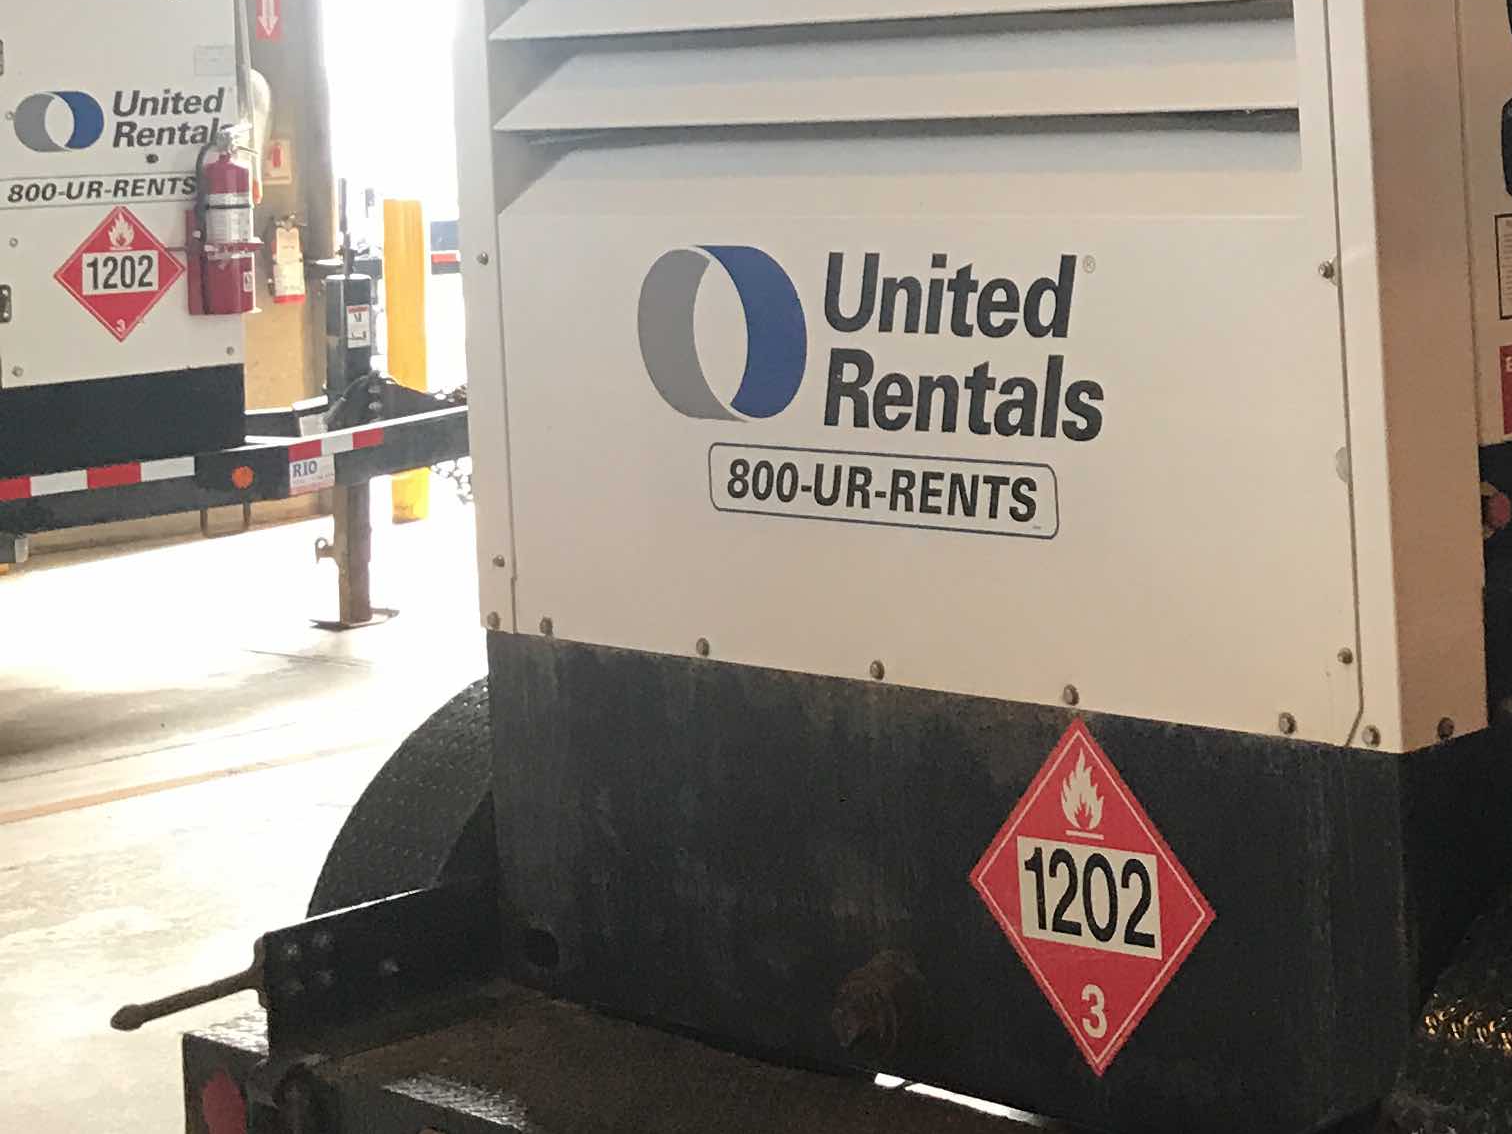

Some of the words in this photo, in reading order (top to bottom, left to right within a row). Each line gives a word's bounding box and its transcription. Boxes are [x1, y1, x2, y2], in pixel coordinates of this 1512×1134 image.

[113, 87, 225, 117] United
[7, 176, 197, 203] 800-UR-RENTS
[87, 254, 153, 290] 1202
[824, 251, 1077, 338] United
[823, 348, 1105, 442] Rentals
[727, 459, 1038, 523] 800-UR-RENTS
[1024, 847, 1156, 948] 1202
[1081, 983, 1107, 1038] 3
